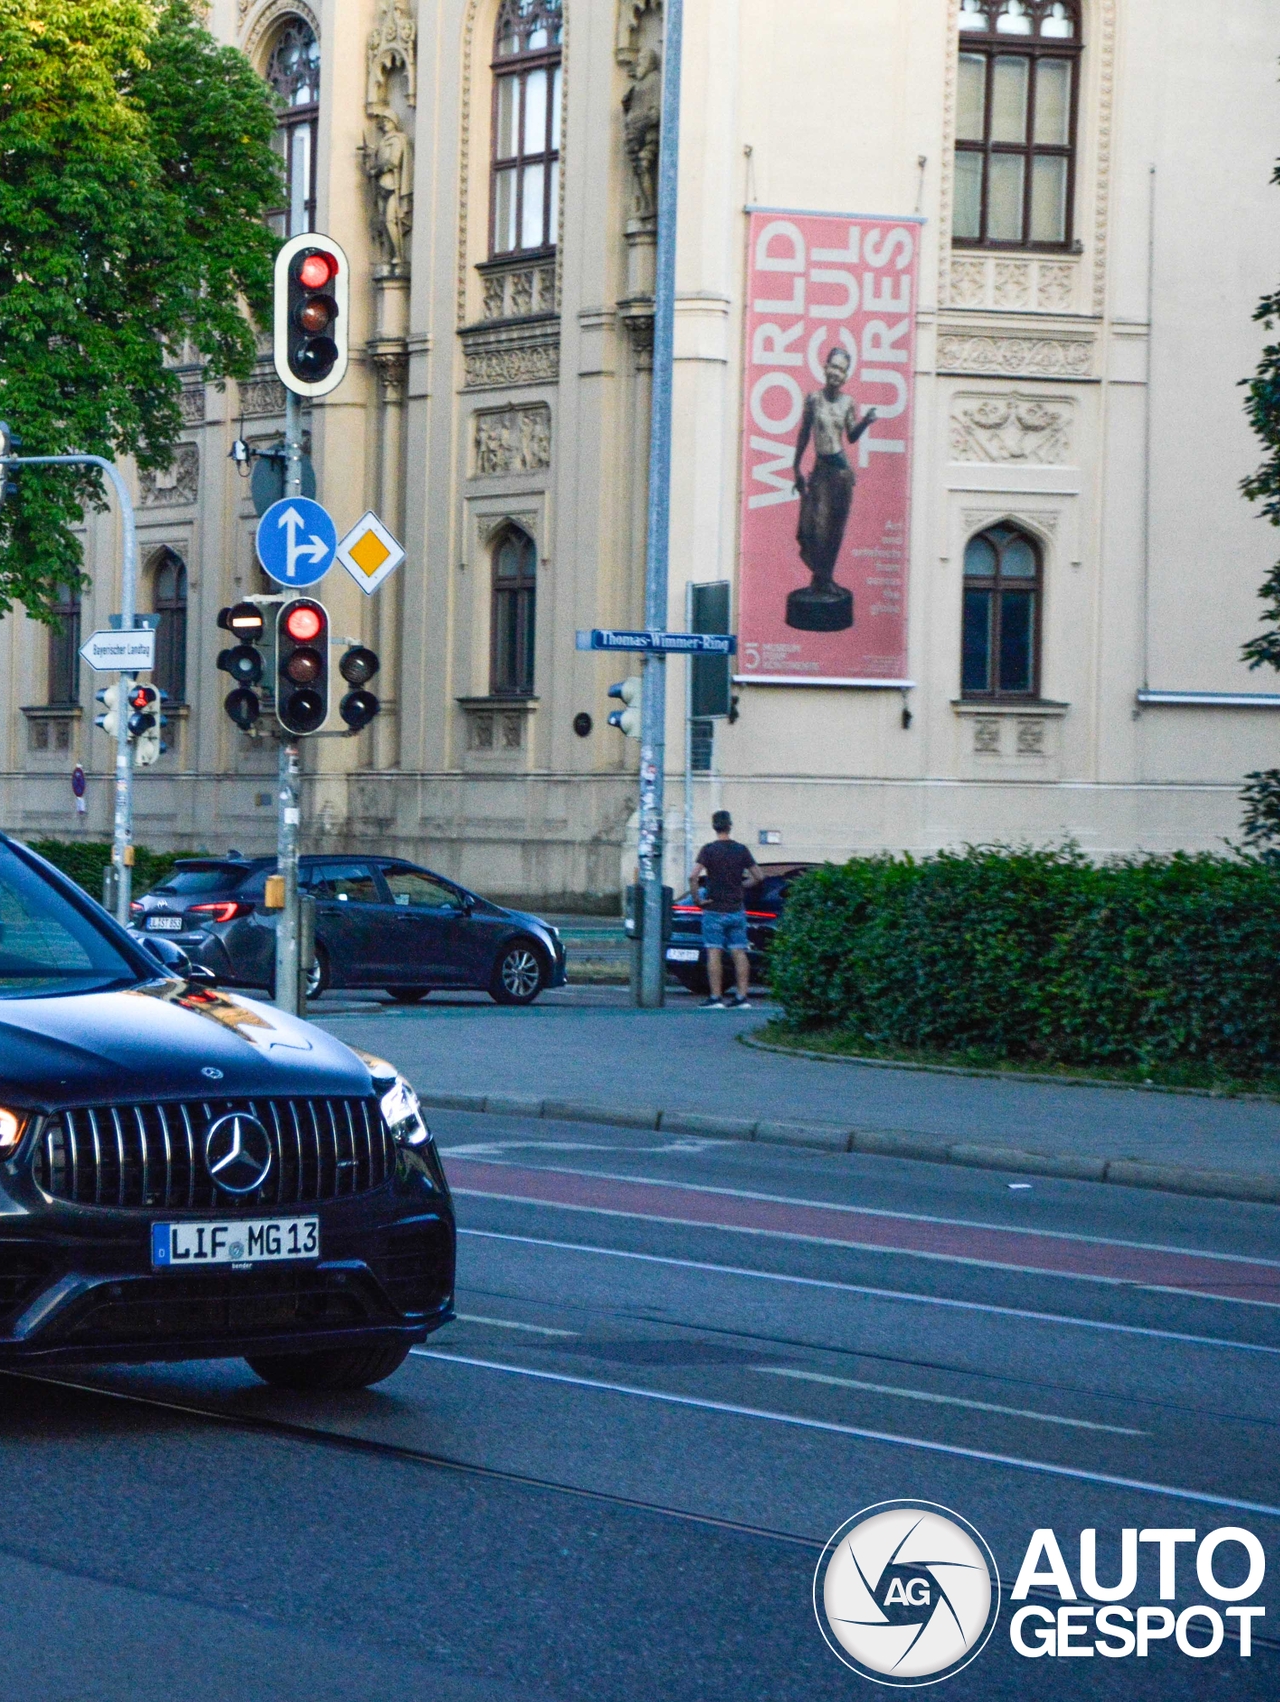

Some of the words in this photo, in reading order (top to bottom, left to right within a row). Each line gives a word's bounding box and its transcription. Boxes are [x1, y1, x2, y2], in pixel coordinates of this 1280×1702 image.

[748, 220, 807, 509] WORLD
[807, 225, 861, 388] CUL
[858, 226, 914, 469] TURES
[599, 630, 730, 652] Thomas-Wimmer-Ring
[172, 1227, 229, 1260] LIF
[247, 1224, 282, 1256] MG
[287, 1222, 317, 1254] 13
